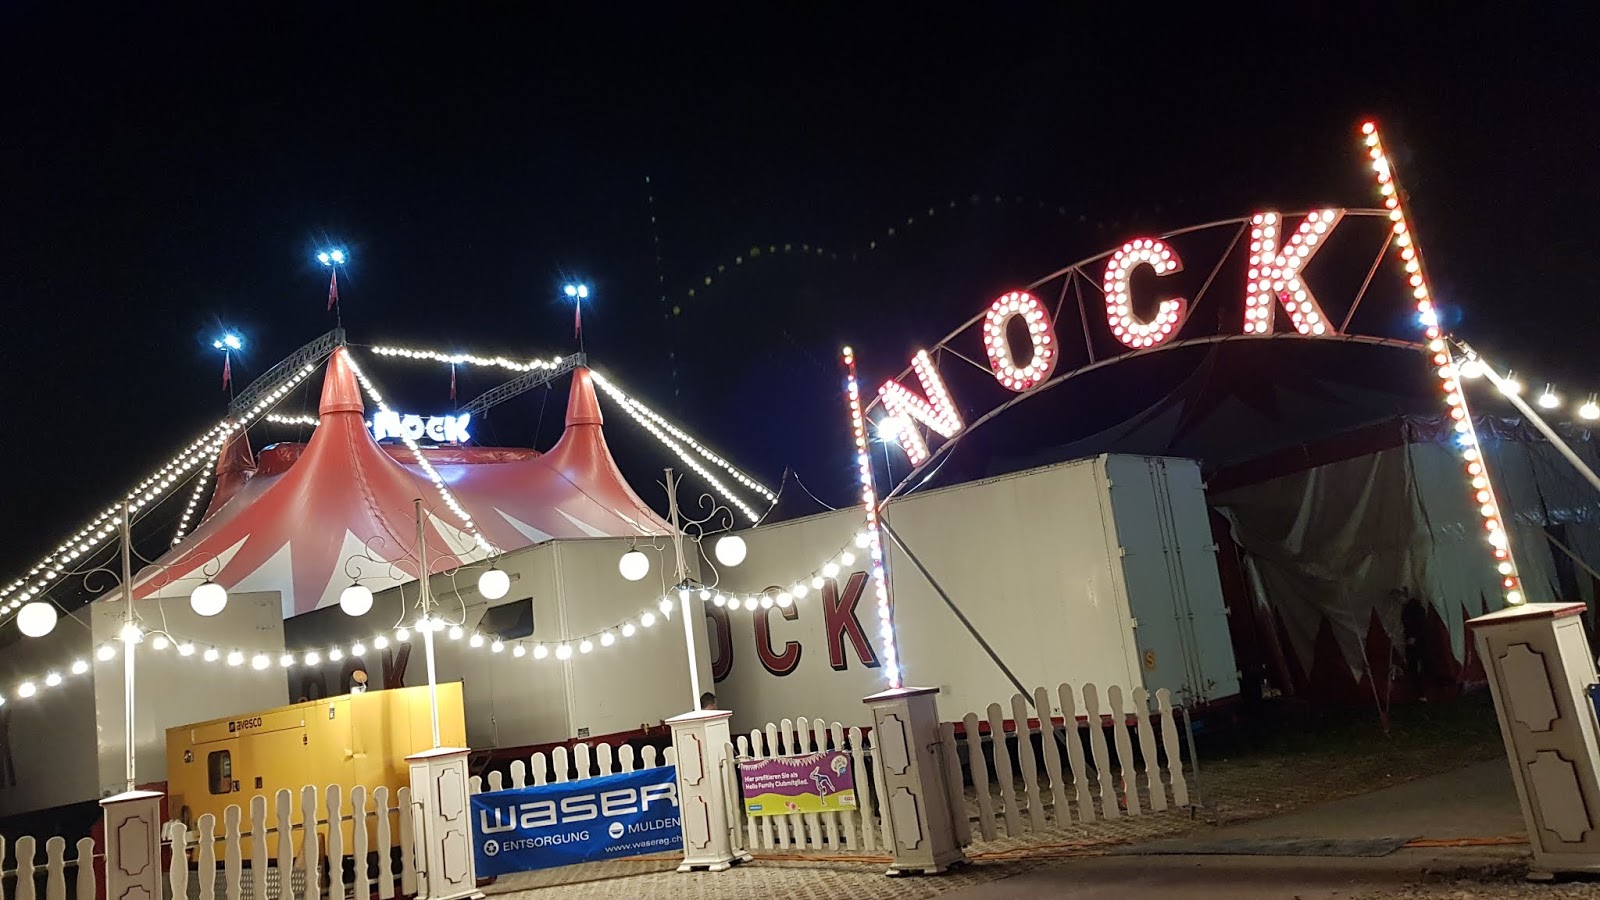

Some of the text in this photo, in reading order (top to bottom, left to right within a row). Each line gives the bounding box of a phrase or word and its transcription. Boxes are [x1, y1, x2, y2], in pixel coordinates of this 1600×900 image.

[878, 208, 1345, 467] NOCK
[374, 411, 471, 443] NOCK
[236, 717, 262, 731] avesco
[755, 773, 781, 782] profitieren
[758, 781, 775, 789] Family
[503, 830, 590, 852] ENTSORGUNG
[604, 835, 683, 853] www.waserag.ch
